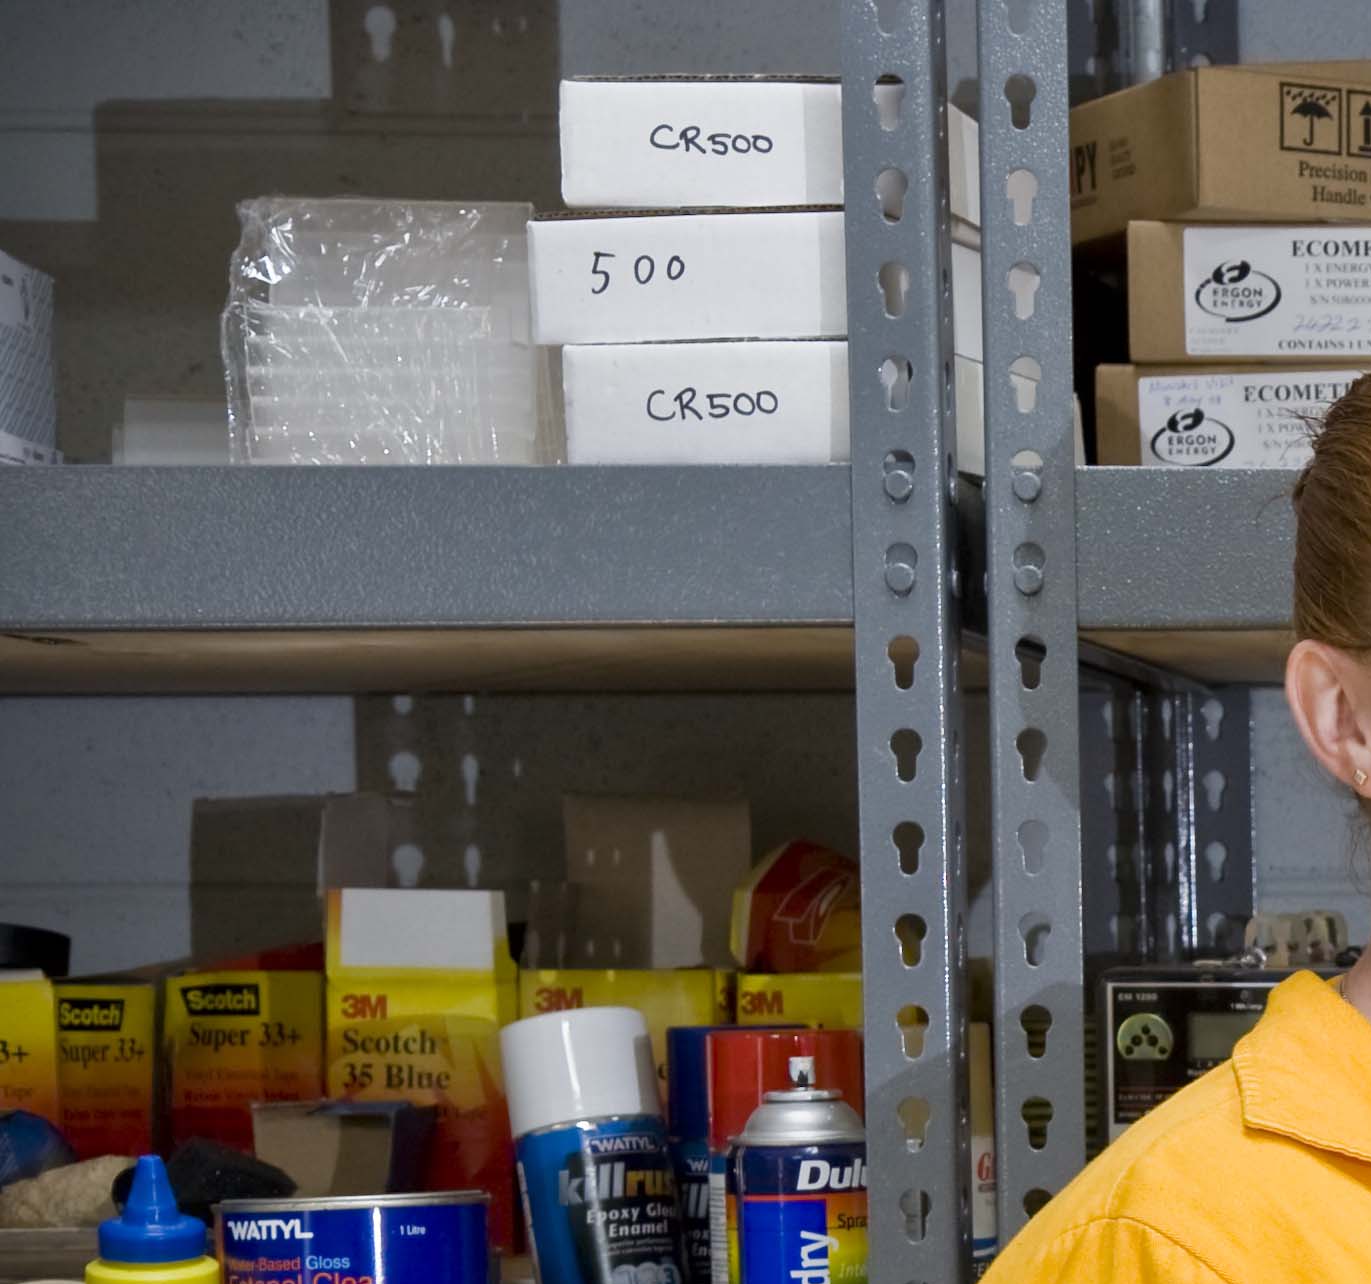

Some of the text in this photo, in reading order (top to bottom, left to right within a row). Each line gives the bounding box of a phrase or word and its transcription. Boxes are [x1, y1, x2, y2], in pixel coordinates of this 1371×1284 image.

[649, 124, 773, 155] CR500
[1070, 140, 1098, 194] PY
[1298, 161, 1368, 184] Precision
[1312, 185, 1366, 207] Handle
[1313, 263, 1322, 273] X
[1212, 288, 1263, 298] ERGON
[1313, 279, 1322, 289] X
[1326, 278, 1370, 289] POWER
[1212, 300, 1262, 308] ENERGY
[1278, 340, 1343, 350] CONTAINS
[646, 386, 779, 421] CR500
[1168, 435, 1217, 446] ERGON
[187, 987, 256, 1011] Scotch
[341, 994, 387, 1020] 3M
[534, 987, 584, 1013] 3M
[741, 990, 784, 1015] 3M
[60, 1002, 121, 1027] Scotch
[188, 1023, 301, 1053] Super 33+
[342, 1028, 437, 1055] Scotch
[59, 1039, 145, 1068] Super 33+
[342, 1063, 451, 1090] 35 Blue
[559, 1162, 676, 1206] killrus
[796, 1158, 867, 1191] Dul
[586, 1206, 639, 1224] Epoxy
[836, 1213, 867, 1230] Spra
[227, 1219, 314, 1241] WATTYL
[407, 1224, 426, 1235] Litre
[608, 1221, 669, 1238] Enamel
[305, 1255, 351, 1271] Gloss
